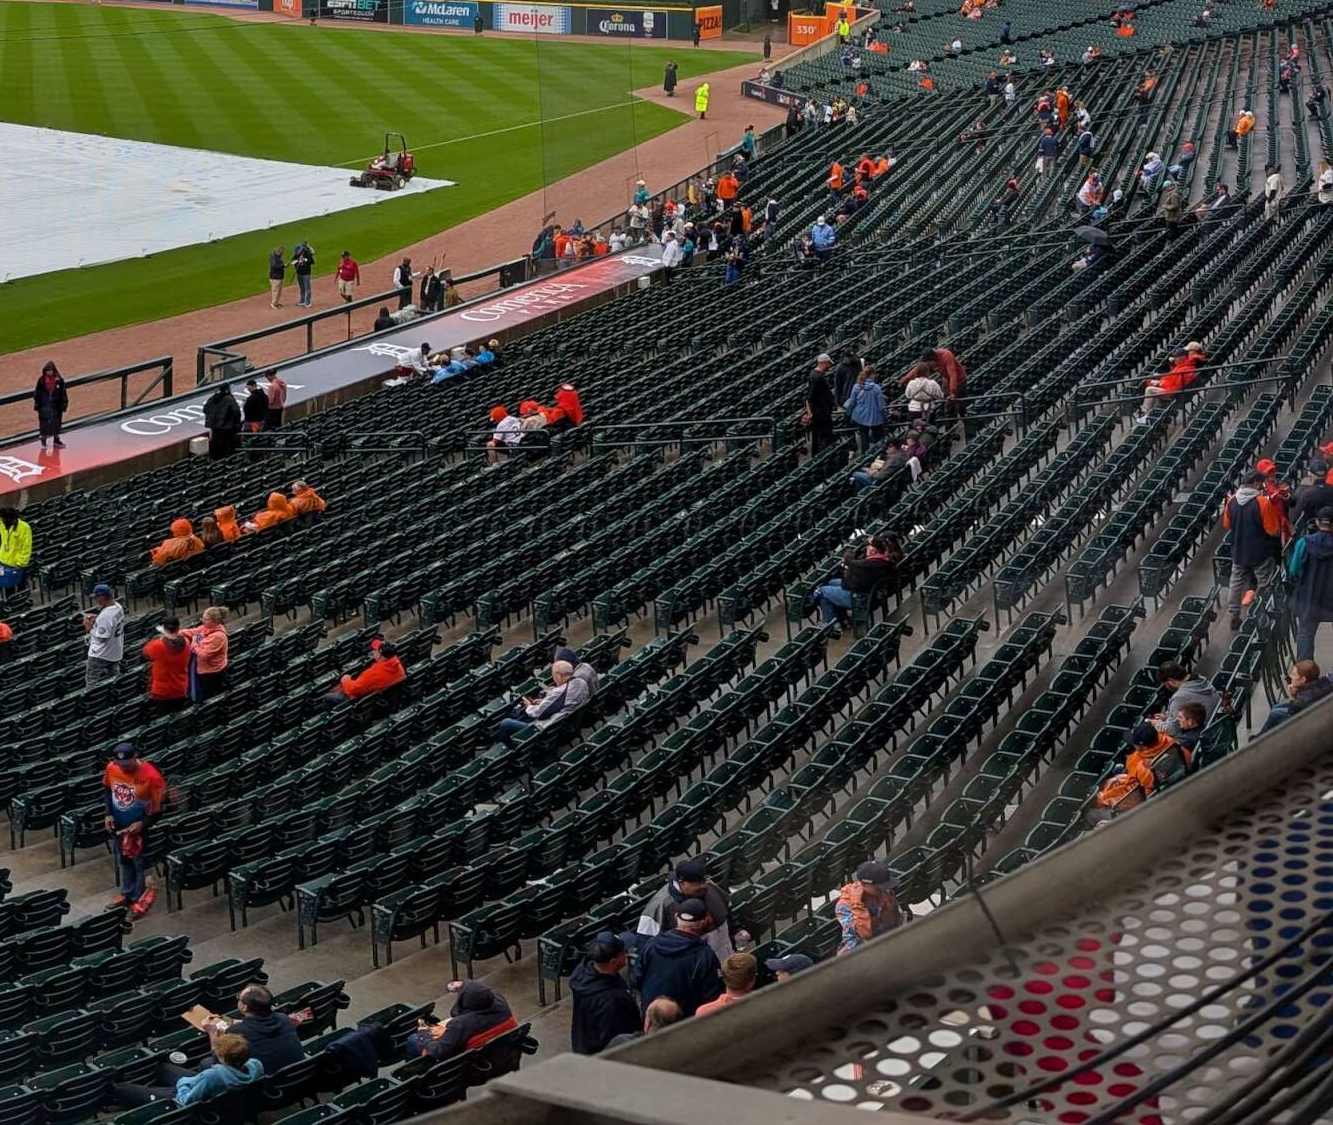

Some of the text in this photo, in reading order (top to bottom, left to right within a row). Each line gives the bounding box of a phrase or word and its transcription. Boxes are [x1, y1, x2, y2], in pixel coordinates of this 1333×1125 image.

[427, 3, 470, 17] McLaren
[422, 17, 460, 26] HEALTH CARE
[508, 9, 554, 30] meijer
[698, 13, 722, 30] PIZZA!
[599, 21, 635, 33] Corona
[796, 25, 818, 35] 330'
